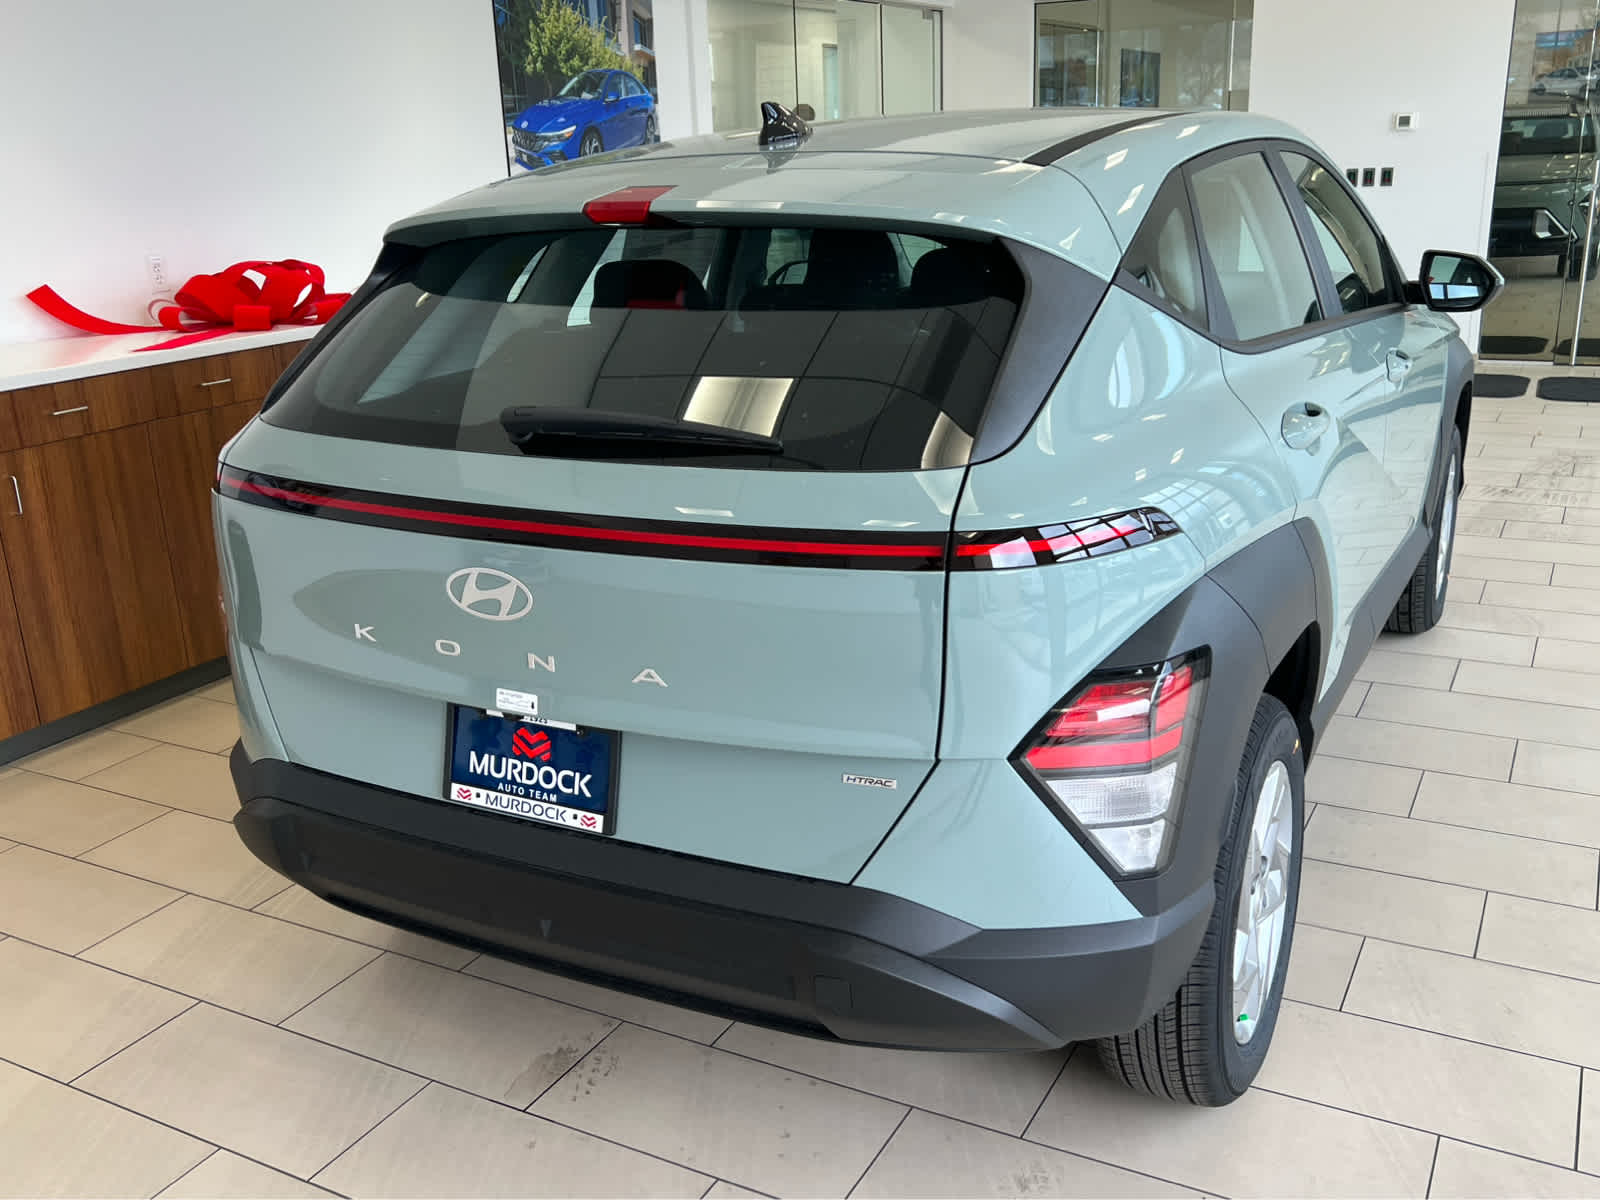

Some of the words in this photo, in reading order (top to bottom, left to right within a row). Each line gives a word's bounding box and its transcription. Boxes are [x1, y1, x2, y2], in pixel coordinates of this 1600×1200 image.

[354, 624, 668, 688] KONA
[469, 751, 592, 798] MURDOCK
[846, 775, 893, 788] HTRAC
[485, 793, 567, 823] MURDOCK
[497, 783, 525, 796] AUTO
[529, 789, 557, 803] TEAM
